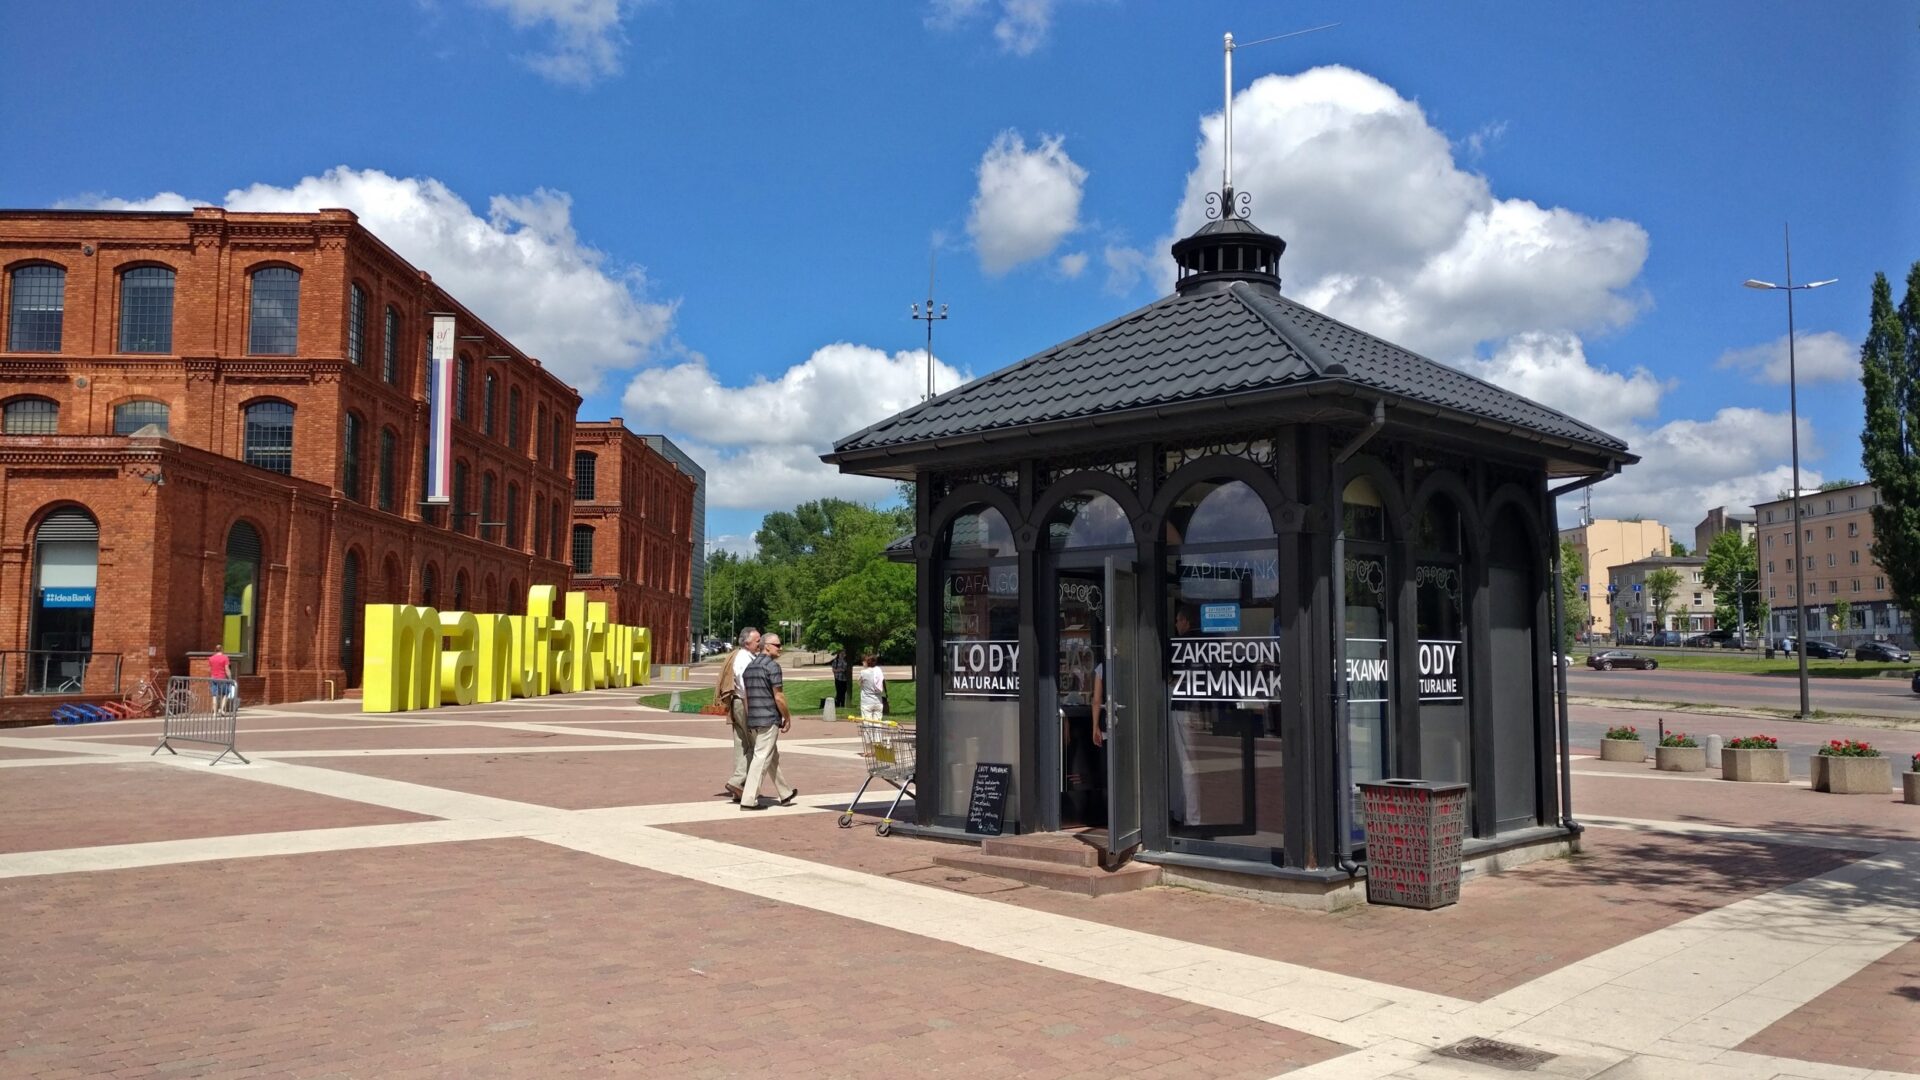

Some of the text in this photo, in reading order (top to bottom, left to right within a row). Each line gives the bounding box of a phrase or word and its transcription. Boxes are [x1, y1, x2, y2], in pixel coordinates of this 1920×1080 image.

[362, 584, 650, 713] manufaktura
[953, 644, 1019, 672] LODY
[1419, 644, 1456, 675] ODY
[953, 676, 1019, 690] NATURALNE
[1172, 670, 1281, 697] ZIEMNIAK
[1419, 678, 1457, 693] TURALNE
[1369, 843, 1429, 862] GARBAGE
